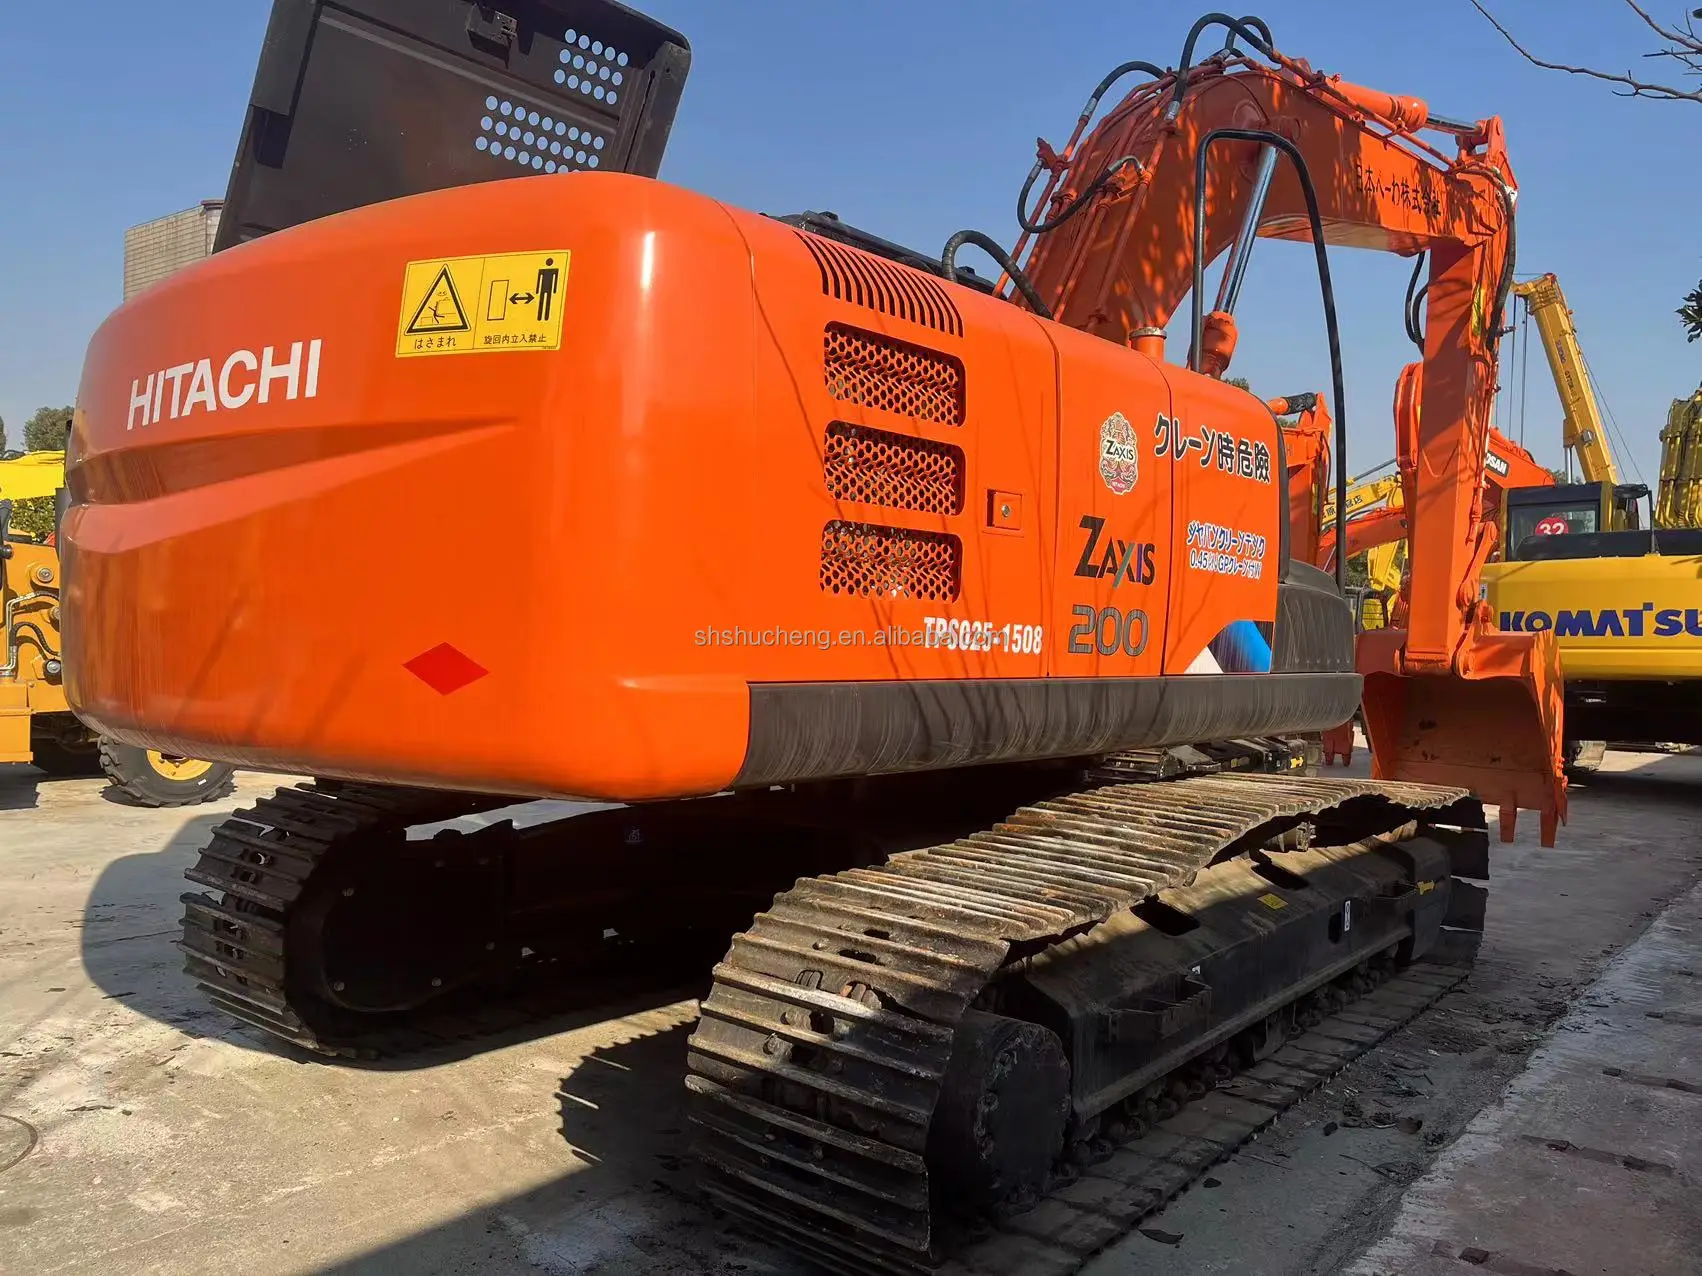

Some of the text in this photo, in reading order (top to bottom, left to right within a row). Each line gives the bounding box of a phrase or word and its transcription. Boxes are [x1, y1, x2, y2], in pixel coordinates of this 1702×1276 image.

[414, 335, 457, 350] はさまれ
[483, 333, 547, 345] 旋回内立入禁止
[126, 339, 322, 431] HITACHI
[1105, 439, 1135, 461] ZAXIS
[1539, 522, 1565, 535] 32
[1074, 514, 1156, 589] ZAXIS
[1067, 604, 1149, 657] 200
